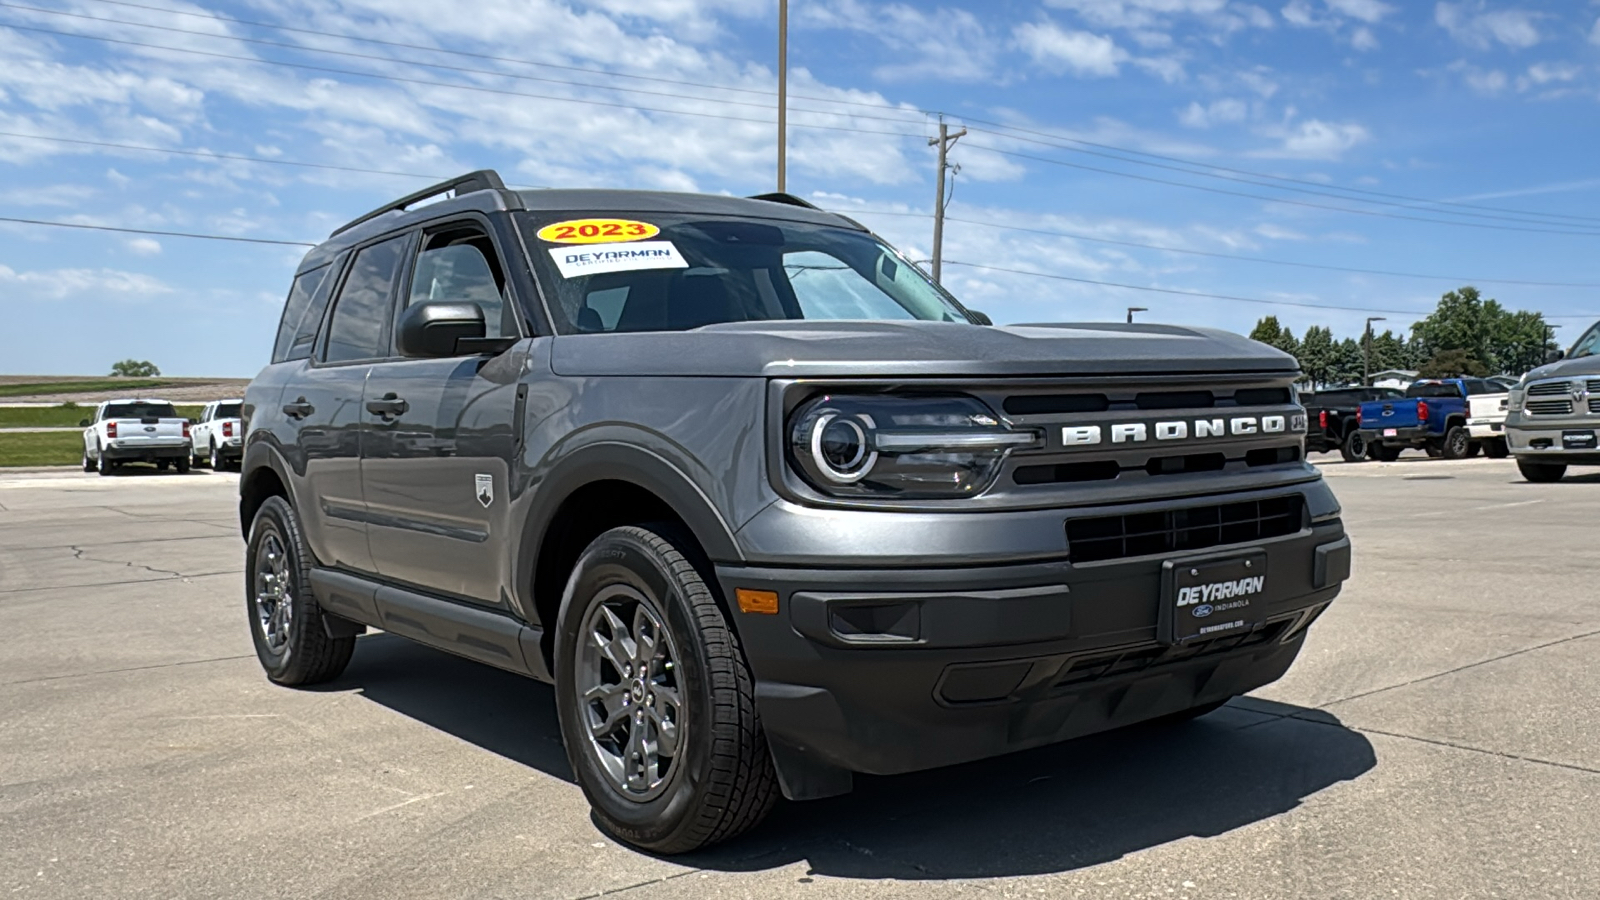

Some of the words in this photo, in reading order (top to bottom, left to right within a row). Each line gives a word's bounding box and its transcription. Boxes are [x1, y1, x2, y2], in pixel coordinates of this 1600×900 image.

[555, 224, 646, 239] 2023
[566, 249, 670, 263] DEYARMAN
[1062, 416, 1285, 445] BRONCO
[1177, 576, 1264, 606] DEYARMAN
[1215, 599, 1249, 611] INDIANOLA
